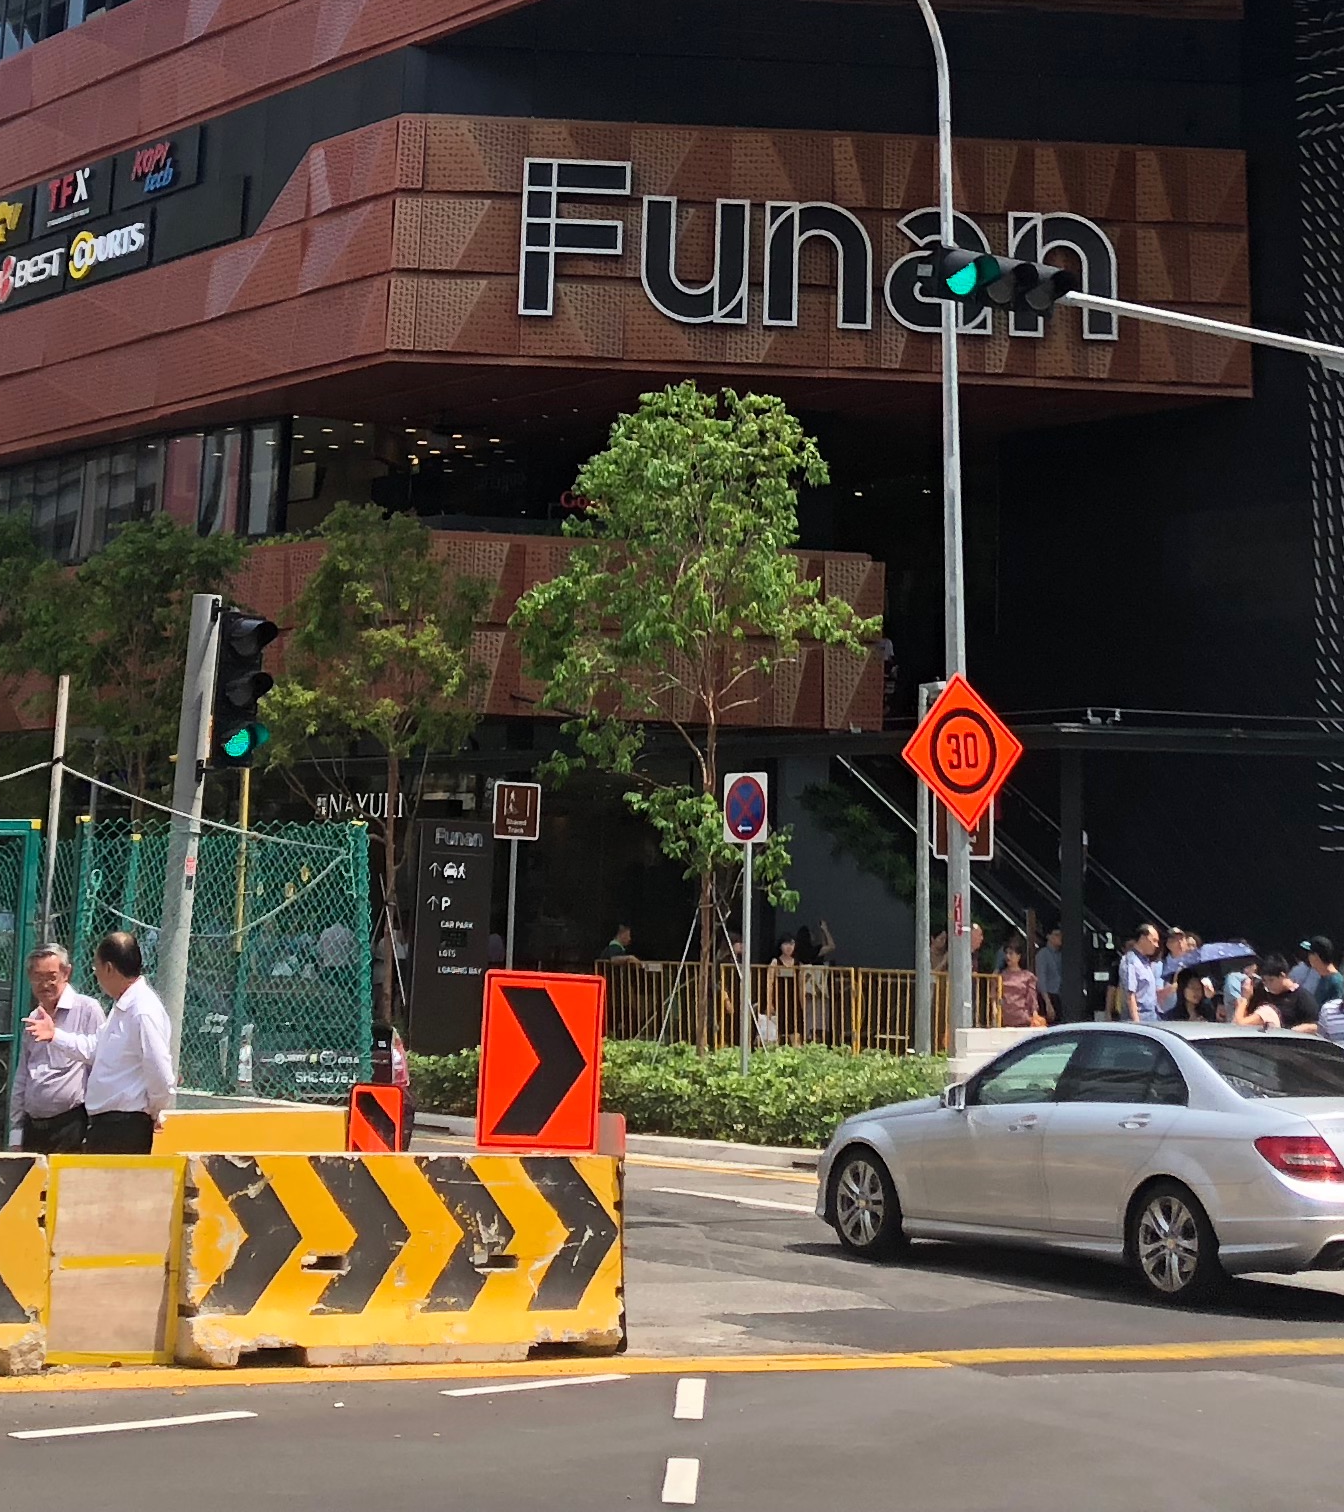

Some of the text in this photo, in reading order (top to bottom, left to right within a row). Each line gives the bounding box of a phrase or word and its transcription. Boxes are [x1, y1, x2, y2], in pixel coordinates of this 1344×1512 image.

[49, 168, 89, 213] TFX
[14, 247, 66, 288] BEST
[70, 222, 146, 271] COURTS
[518, 157, 1118, 340] Funan
[946, 732, 979, 770] 30
[434, 827, 484, 848] Funan
